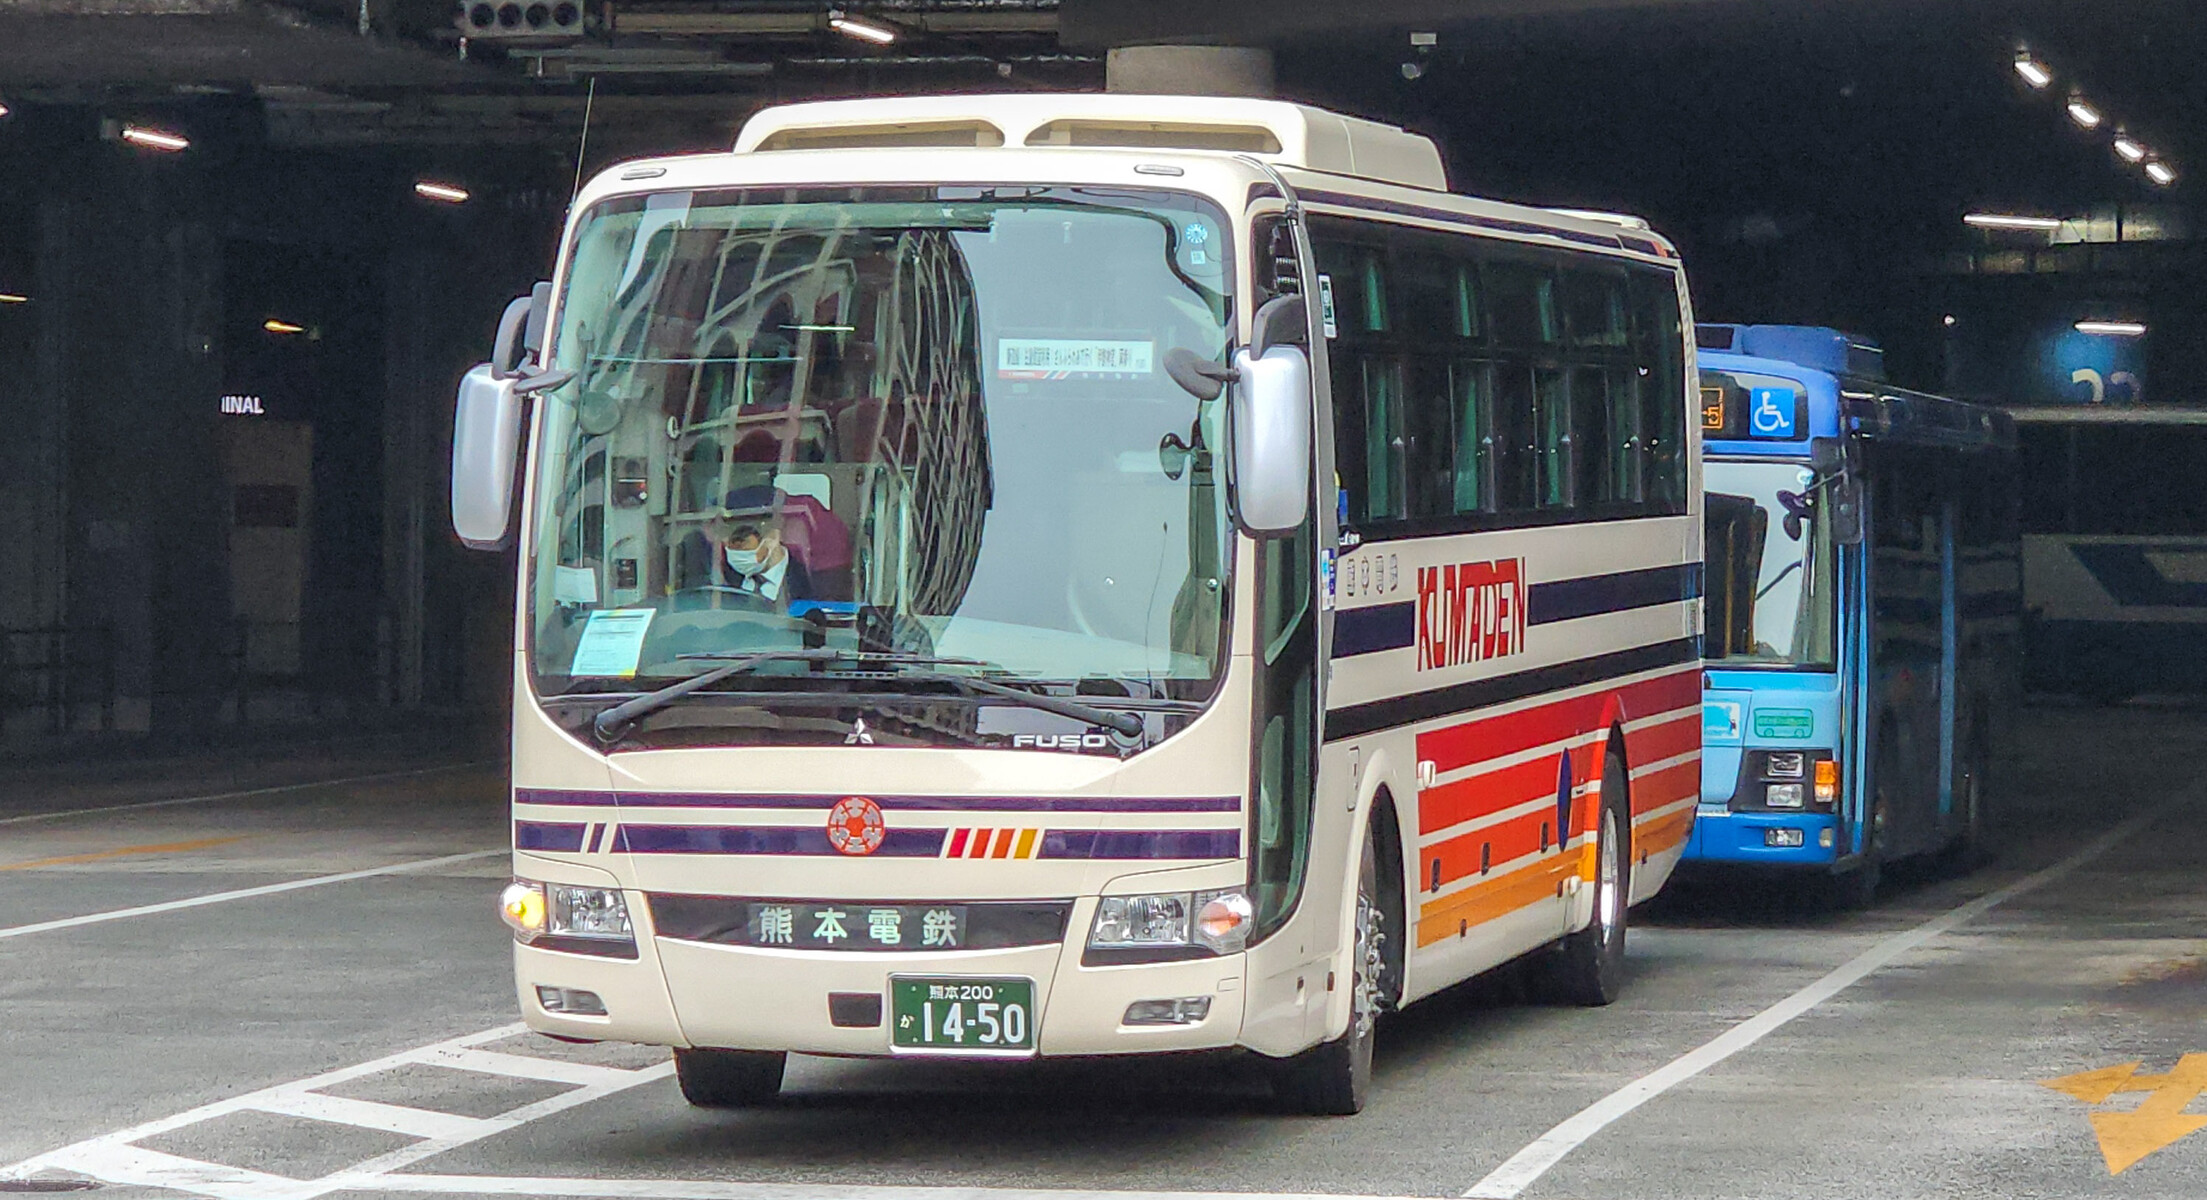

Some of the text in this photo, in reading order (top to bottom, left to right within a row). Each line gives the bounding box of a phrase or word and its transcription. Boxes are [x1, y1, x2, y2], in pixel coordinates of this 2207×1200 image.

[1417, 556, 1526, 672] KUMADEN
[1013, 733, 1107, 748] FUSO
[759, 905, 957, 946] 熊本電鉄
[923, 1001, 1025, 1044] 14-50
